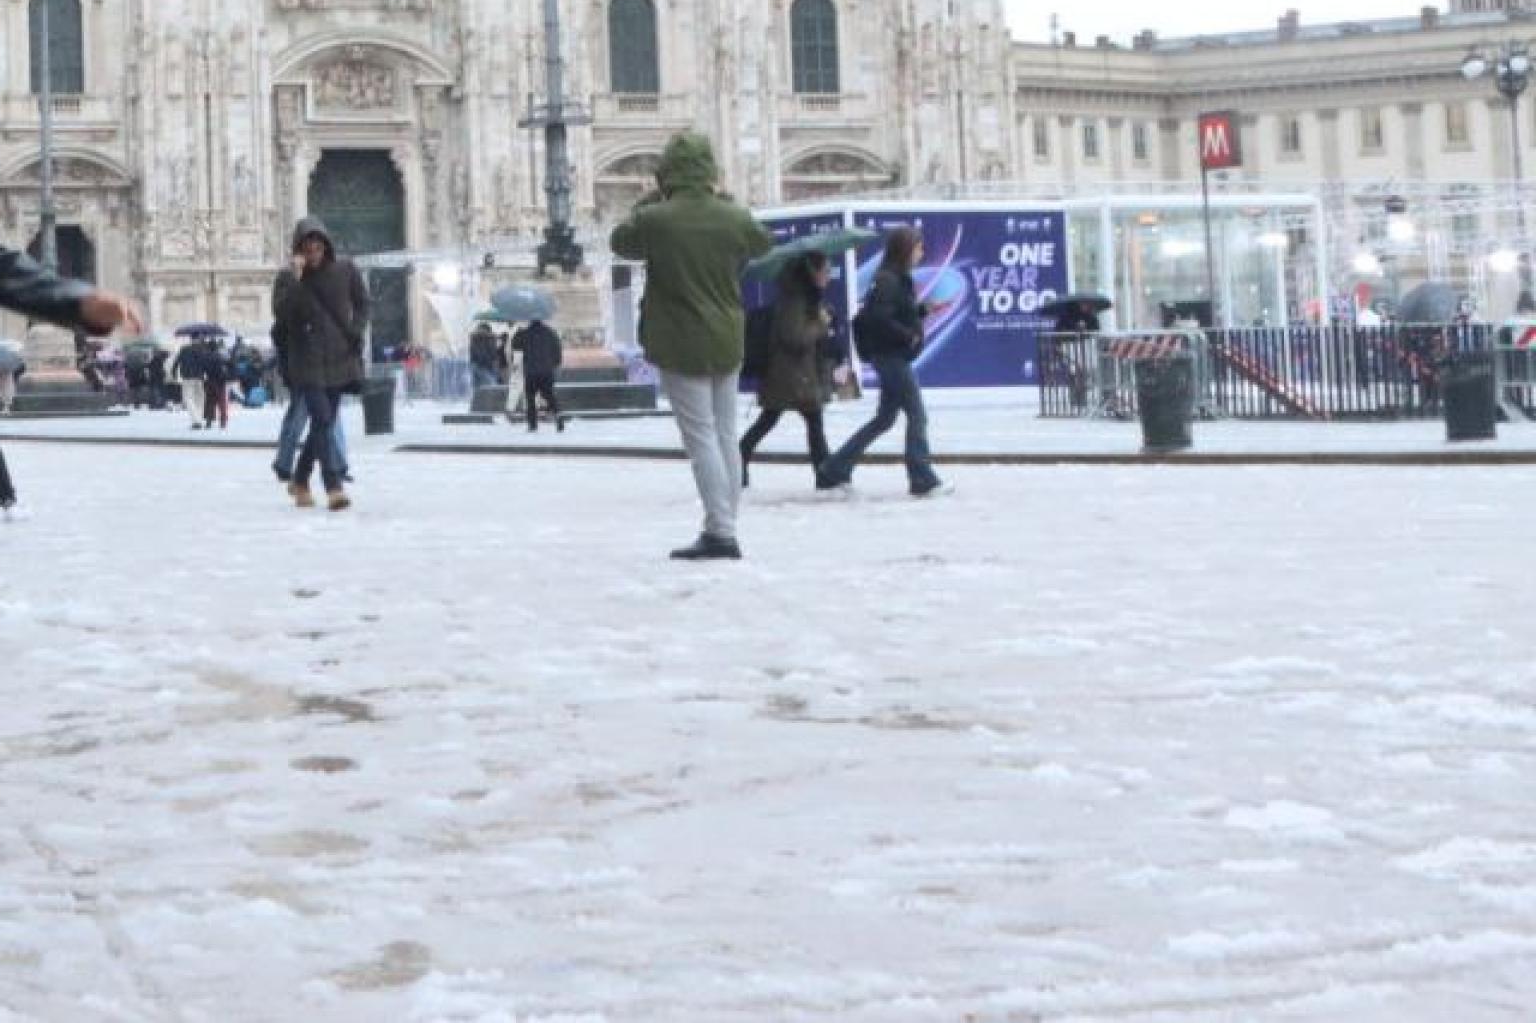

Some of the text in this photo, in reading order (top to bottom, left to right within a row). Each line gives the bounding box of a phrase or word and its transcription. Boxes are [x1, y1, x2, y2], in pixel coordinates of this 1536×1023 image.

[1204, 124, 1230, 156] M
[1000, 242, 1056, 266] ONE
[971, 266, 1039, 290] YEAR
[978, 289, 1013, 313] TO
